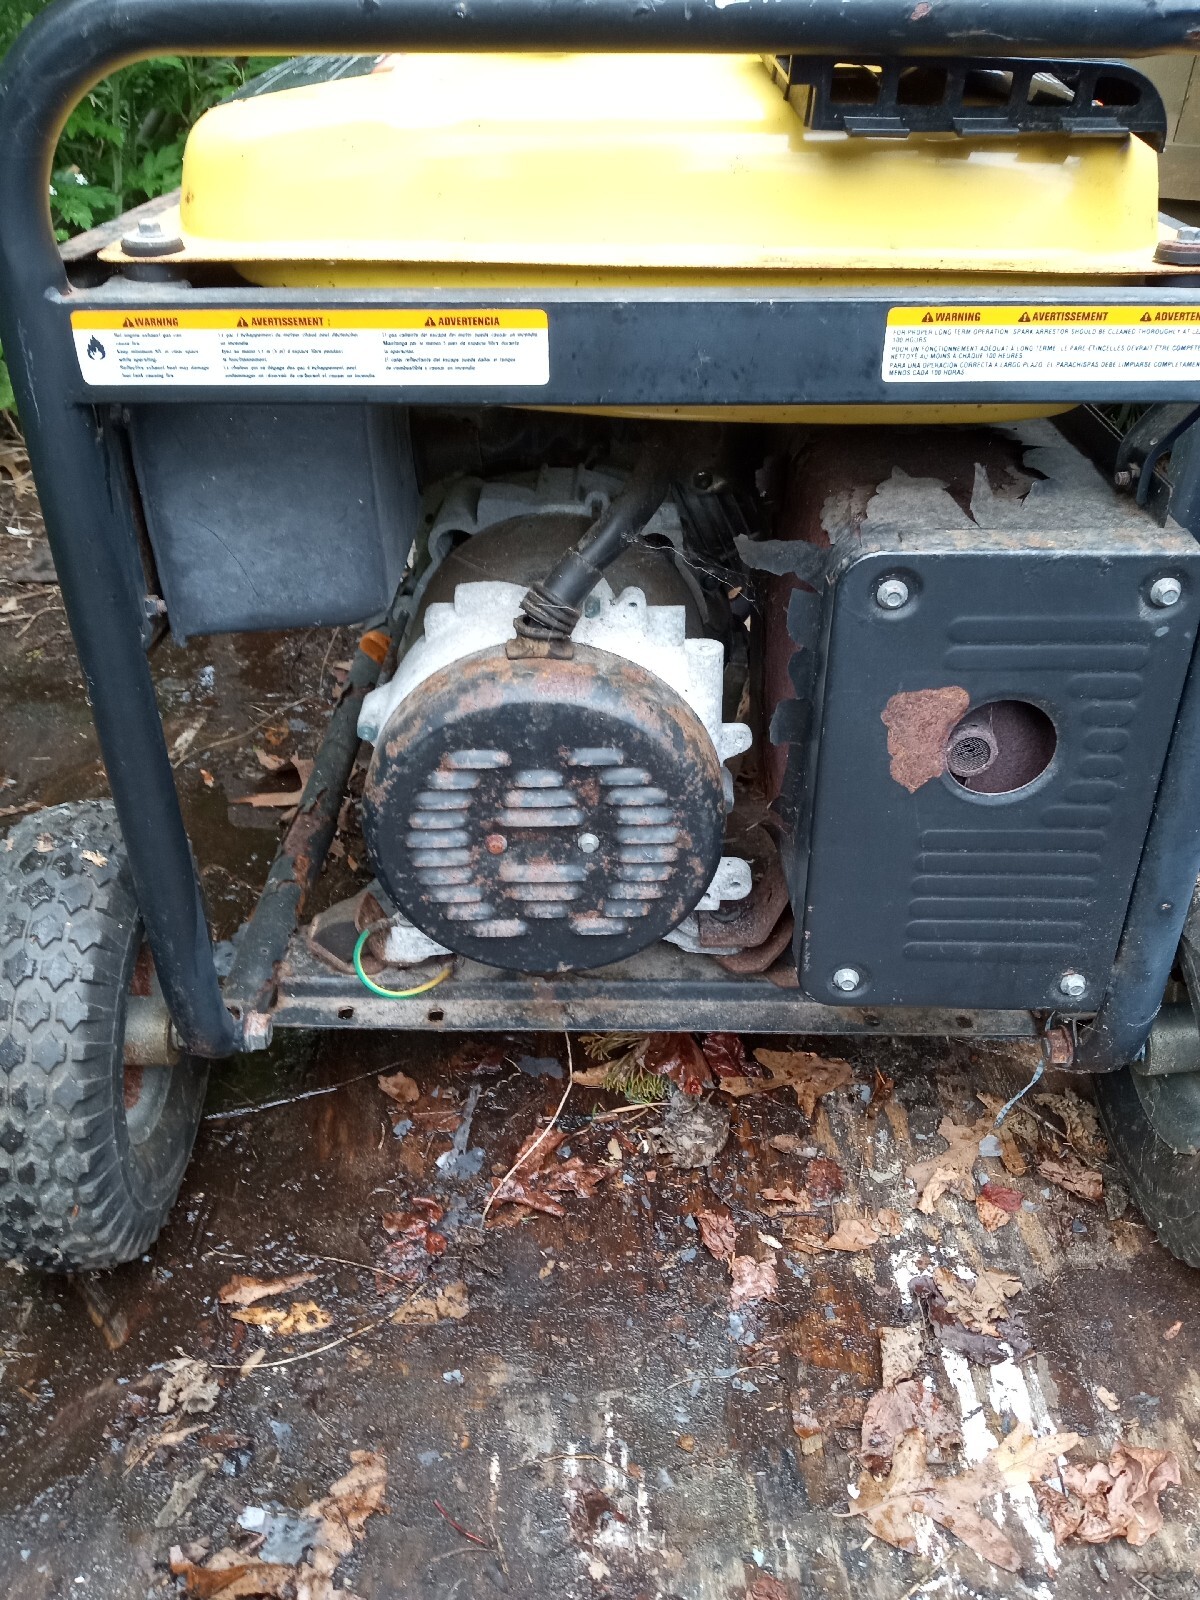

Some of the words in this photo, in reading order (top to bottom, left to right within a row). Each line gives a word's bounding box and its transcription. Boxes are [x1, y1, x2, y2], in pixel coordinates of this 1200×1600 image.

[251, 316, 323, 326] AVERTISSEMENT
[438, 316, 500, 326] ADVERTENCIA
[935, 312, 981, 322] WARNING
[1032, 311, 1109, 321] AVERTISSEMENT
[135, 317, 179, 327] WARNING
